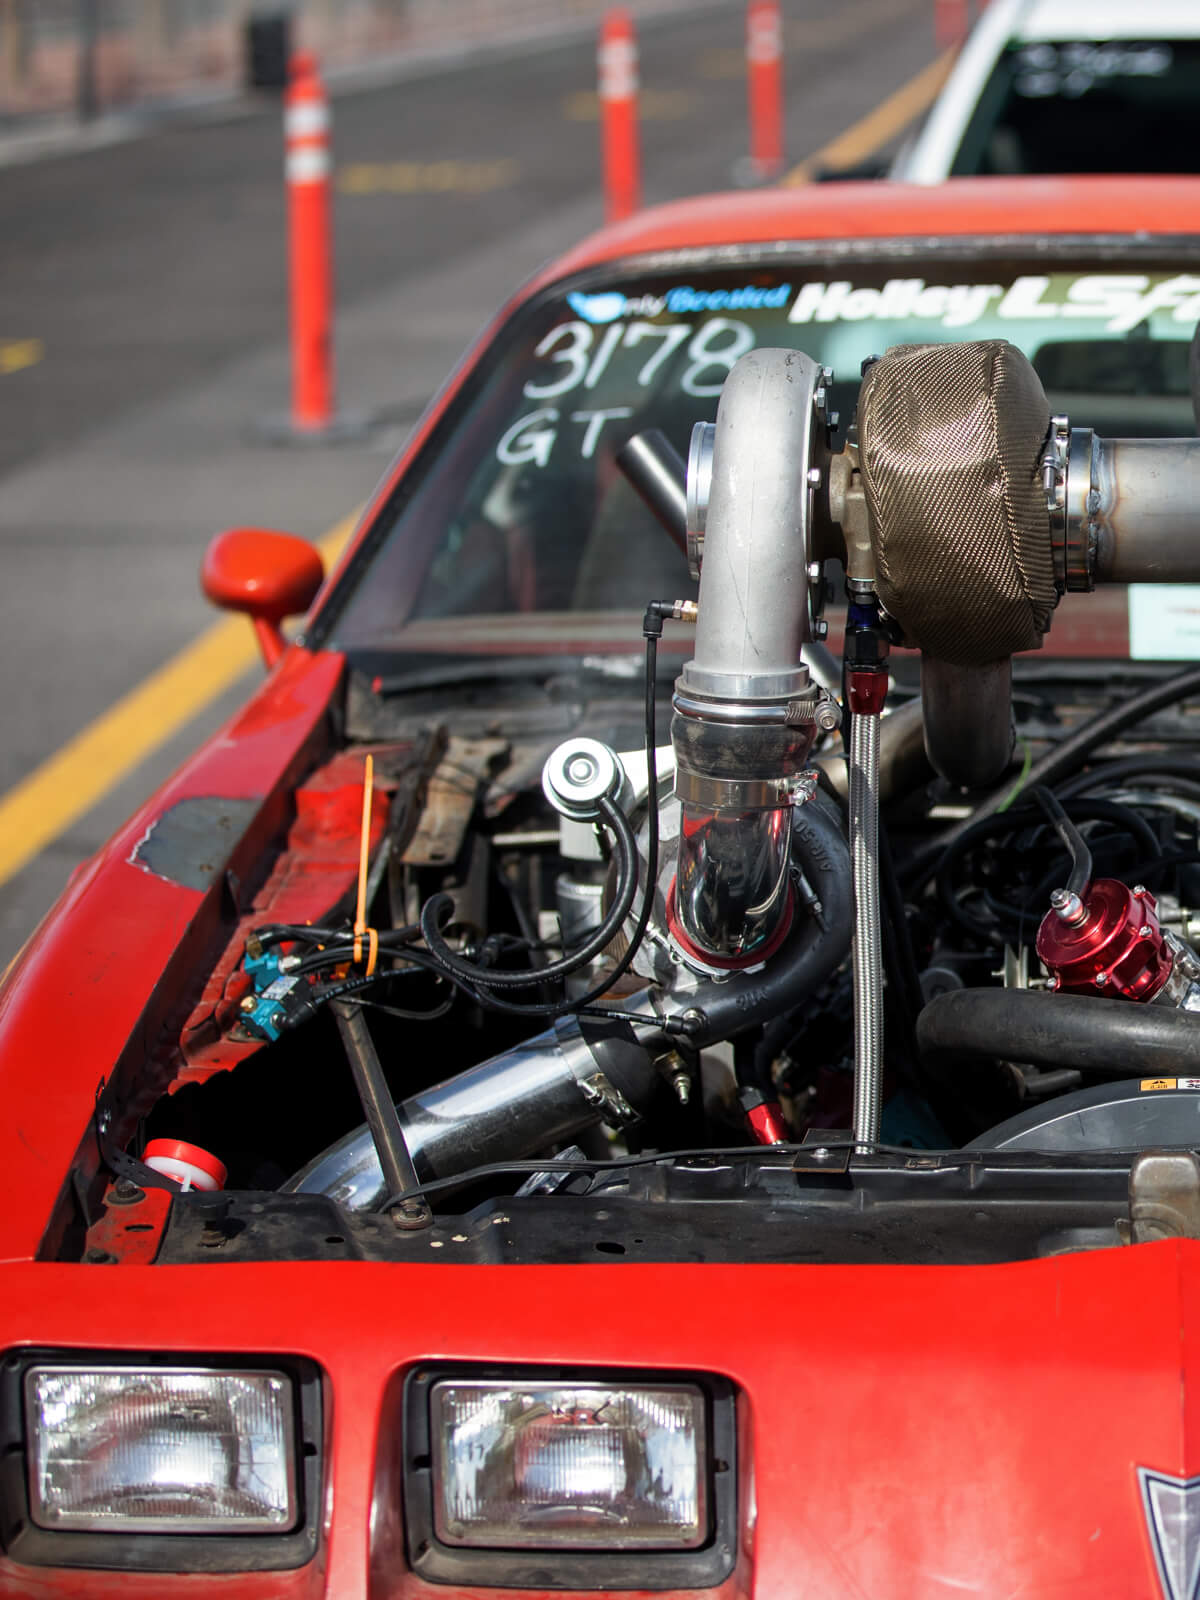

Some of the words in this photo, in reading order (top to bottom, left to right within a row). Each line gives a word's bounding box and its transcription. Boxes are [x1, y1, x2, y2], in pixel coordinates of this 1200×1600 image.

[788, 278, 1004, 327] Holley
[523, 317, 755, 398] 3178
[496, 407, 632, 467] GT
